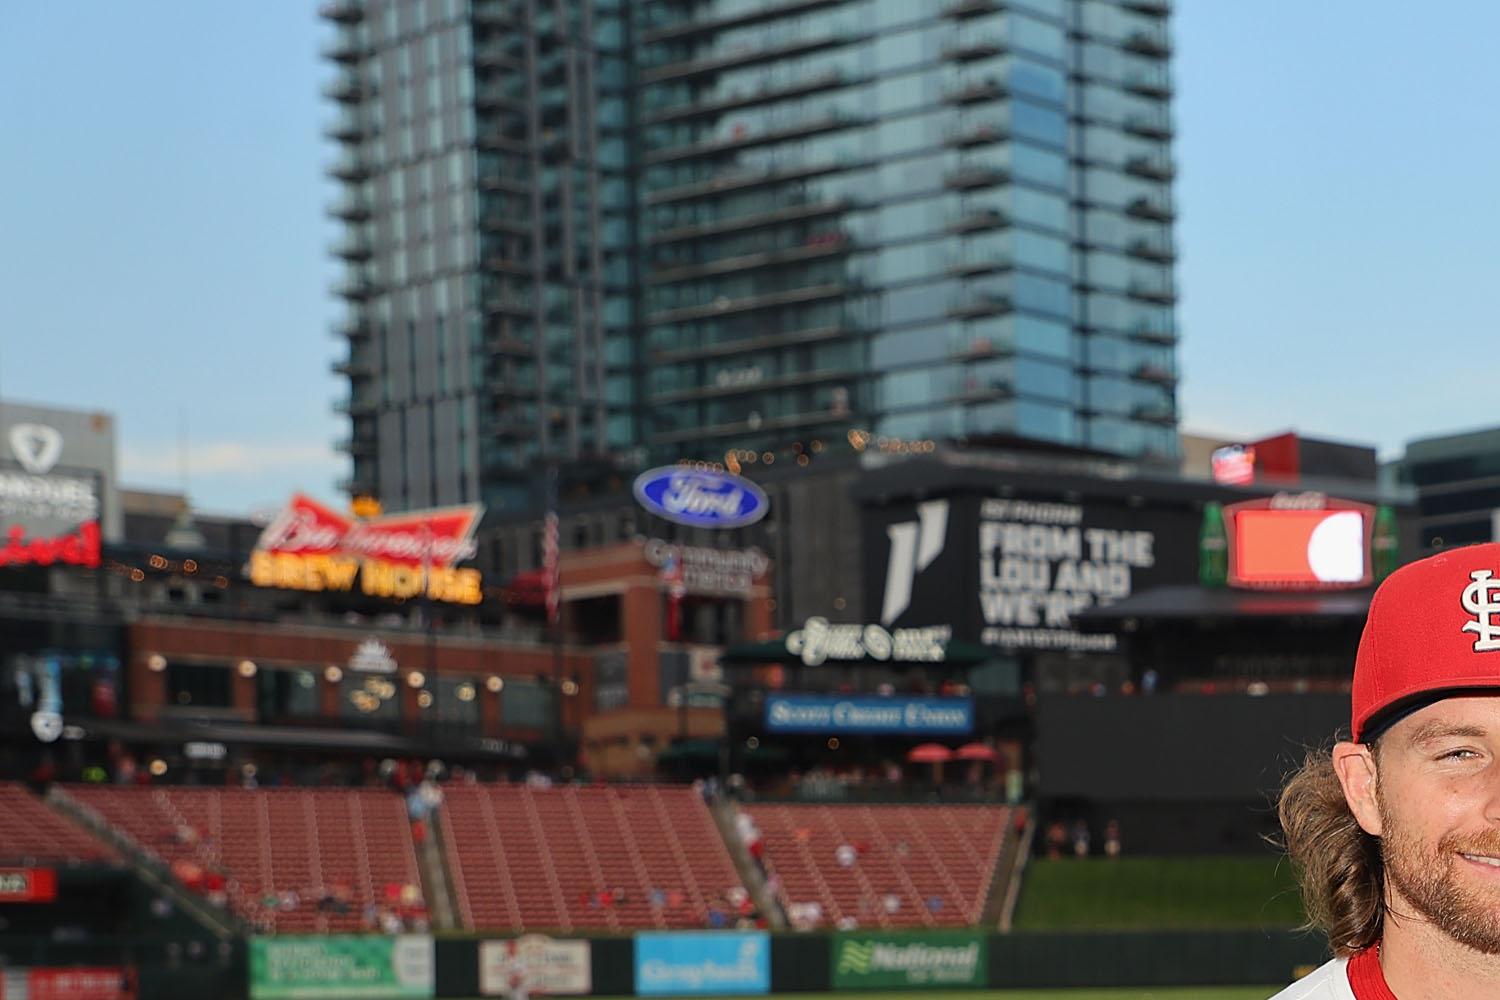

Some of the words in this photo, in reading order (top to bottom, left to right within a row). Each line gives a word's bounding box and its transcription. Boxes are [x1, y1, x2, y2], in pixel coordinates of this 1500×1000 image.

[979, 521, 1082, 560] FROM
[1084, 528, 1155, 567] THE
[980, 556, 1050, 592] LOU
[1054, 560, 1131, 598] AND
[873, 942, 981, 970] National
